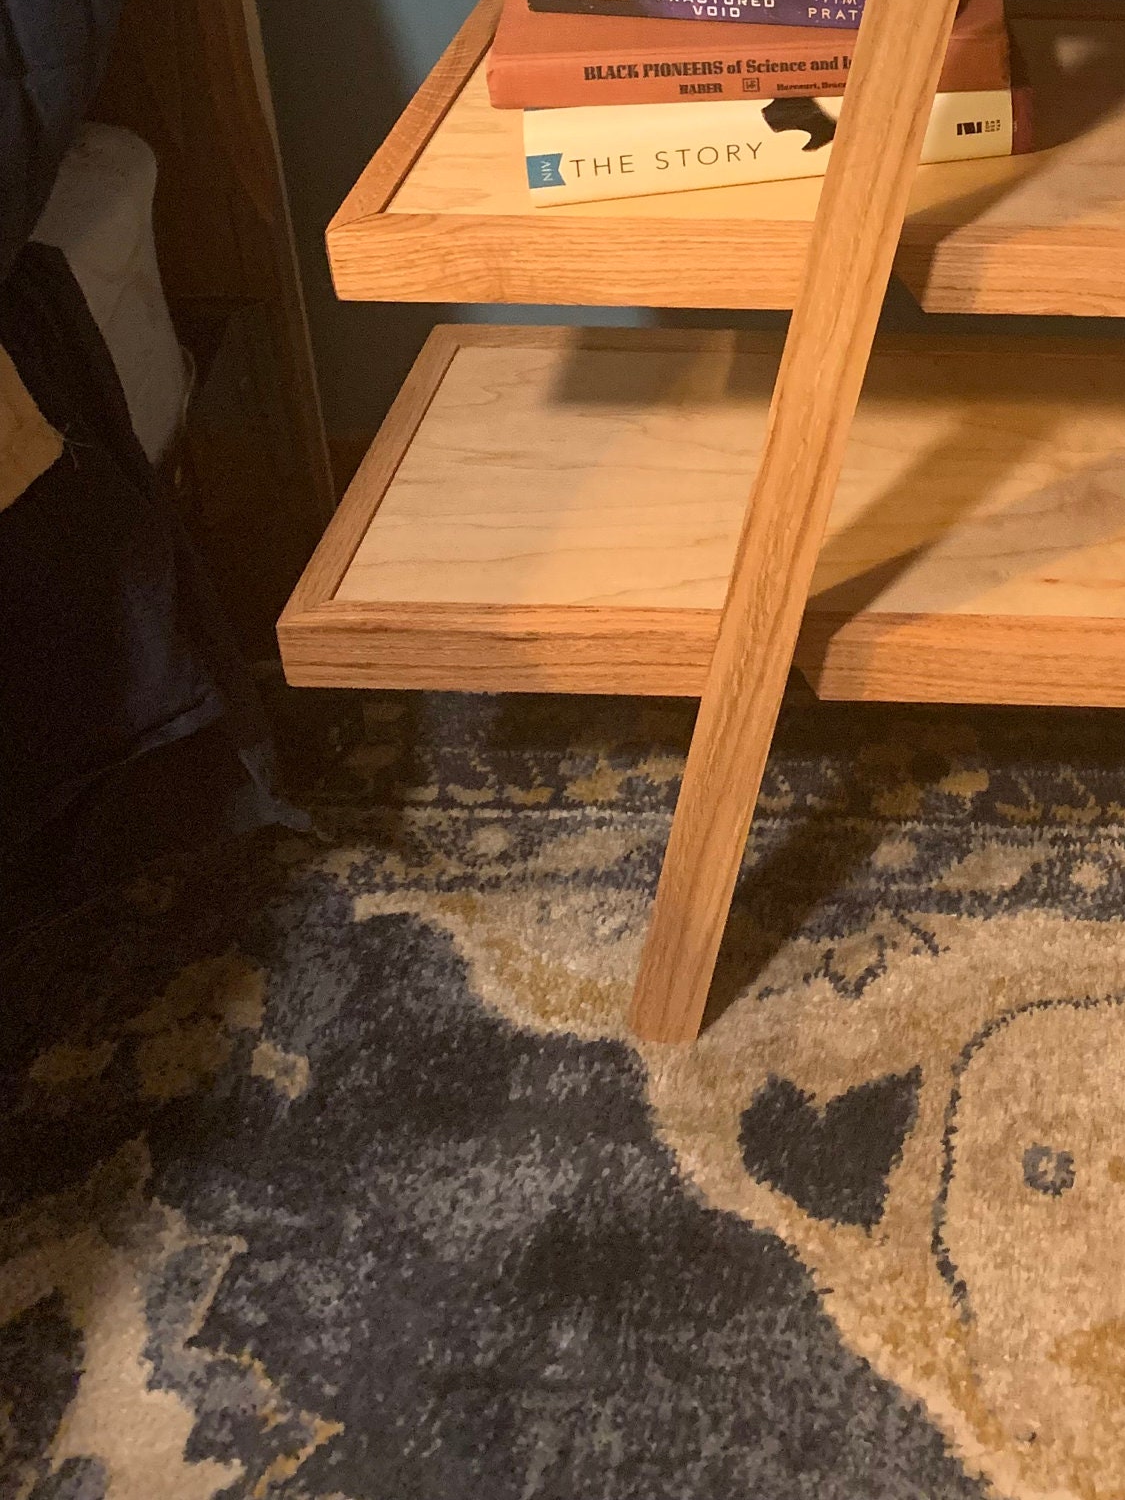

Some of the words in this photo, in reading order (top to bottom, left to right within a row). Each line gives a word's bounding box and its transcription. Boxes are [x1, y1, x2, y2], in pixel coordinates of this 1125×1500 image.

[693, 5, 741, 18] VOID
[808, 7, 864, 21] PRAT
[584, 64, 639, 80] BLACK
[643, 61, 723, 78] PIONEERS
[727, 60, 742, 74] of
[746, 59, 807, 73] Science
[810, 56, 839, 70] and
[569, 154, 635, 178] THE
[655, 141, 763, 170] STORY
[541, 160, 553, 182] NIV
